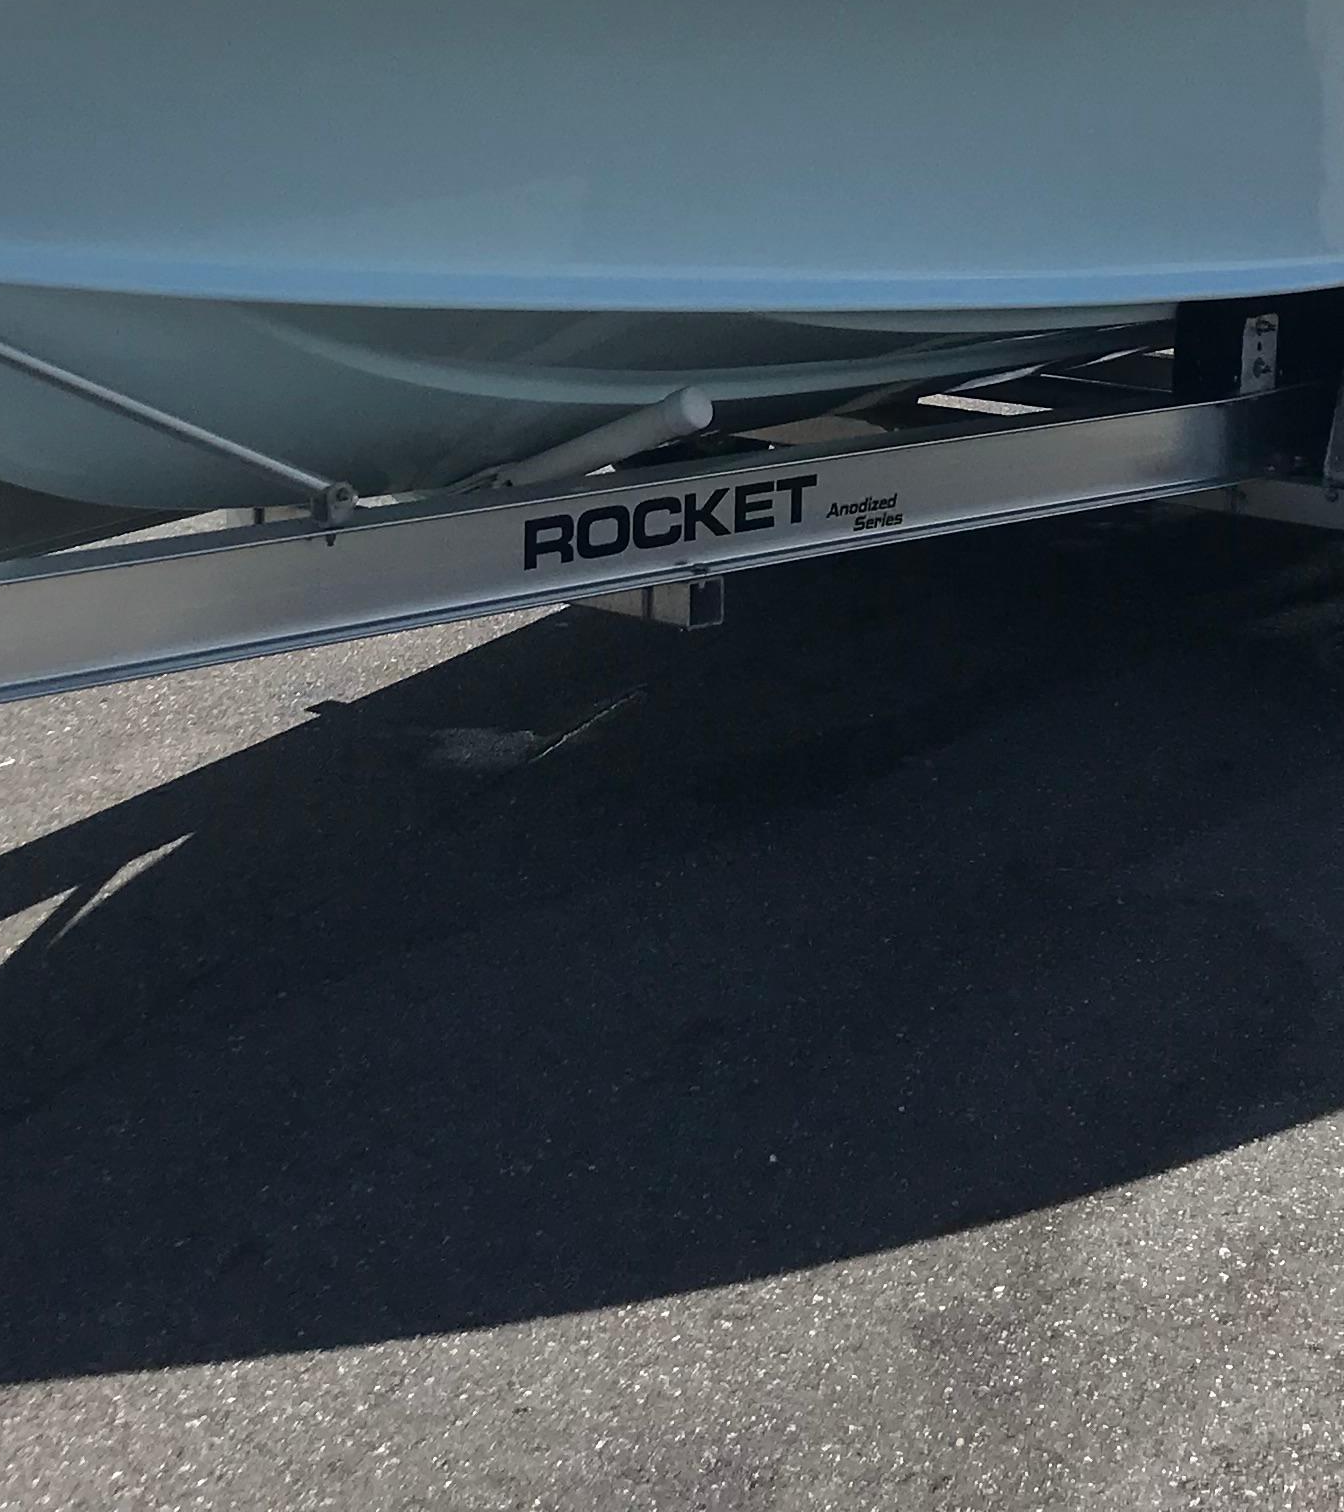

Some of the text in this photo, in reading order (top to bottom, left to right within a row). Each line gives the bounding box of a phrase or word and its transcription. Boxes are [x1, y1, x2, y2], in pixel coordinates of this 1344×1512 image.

[826, 493, 898, 519] Anodized
[523, 474, 818, 571] ROCKET
[853, 511, 904, 532] Series
